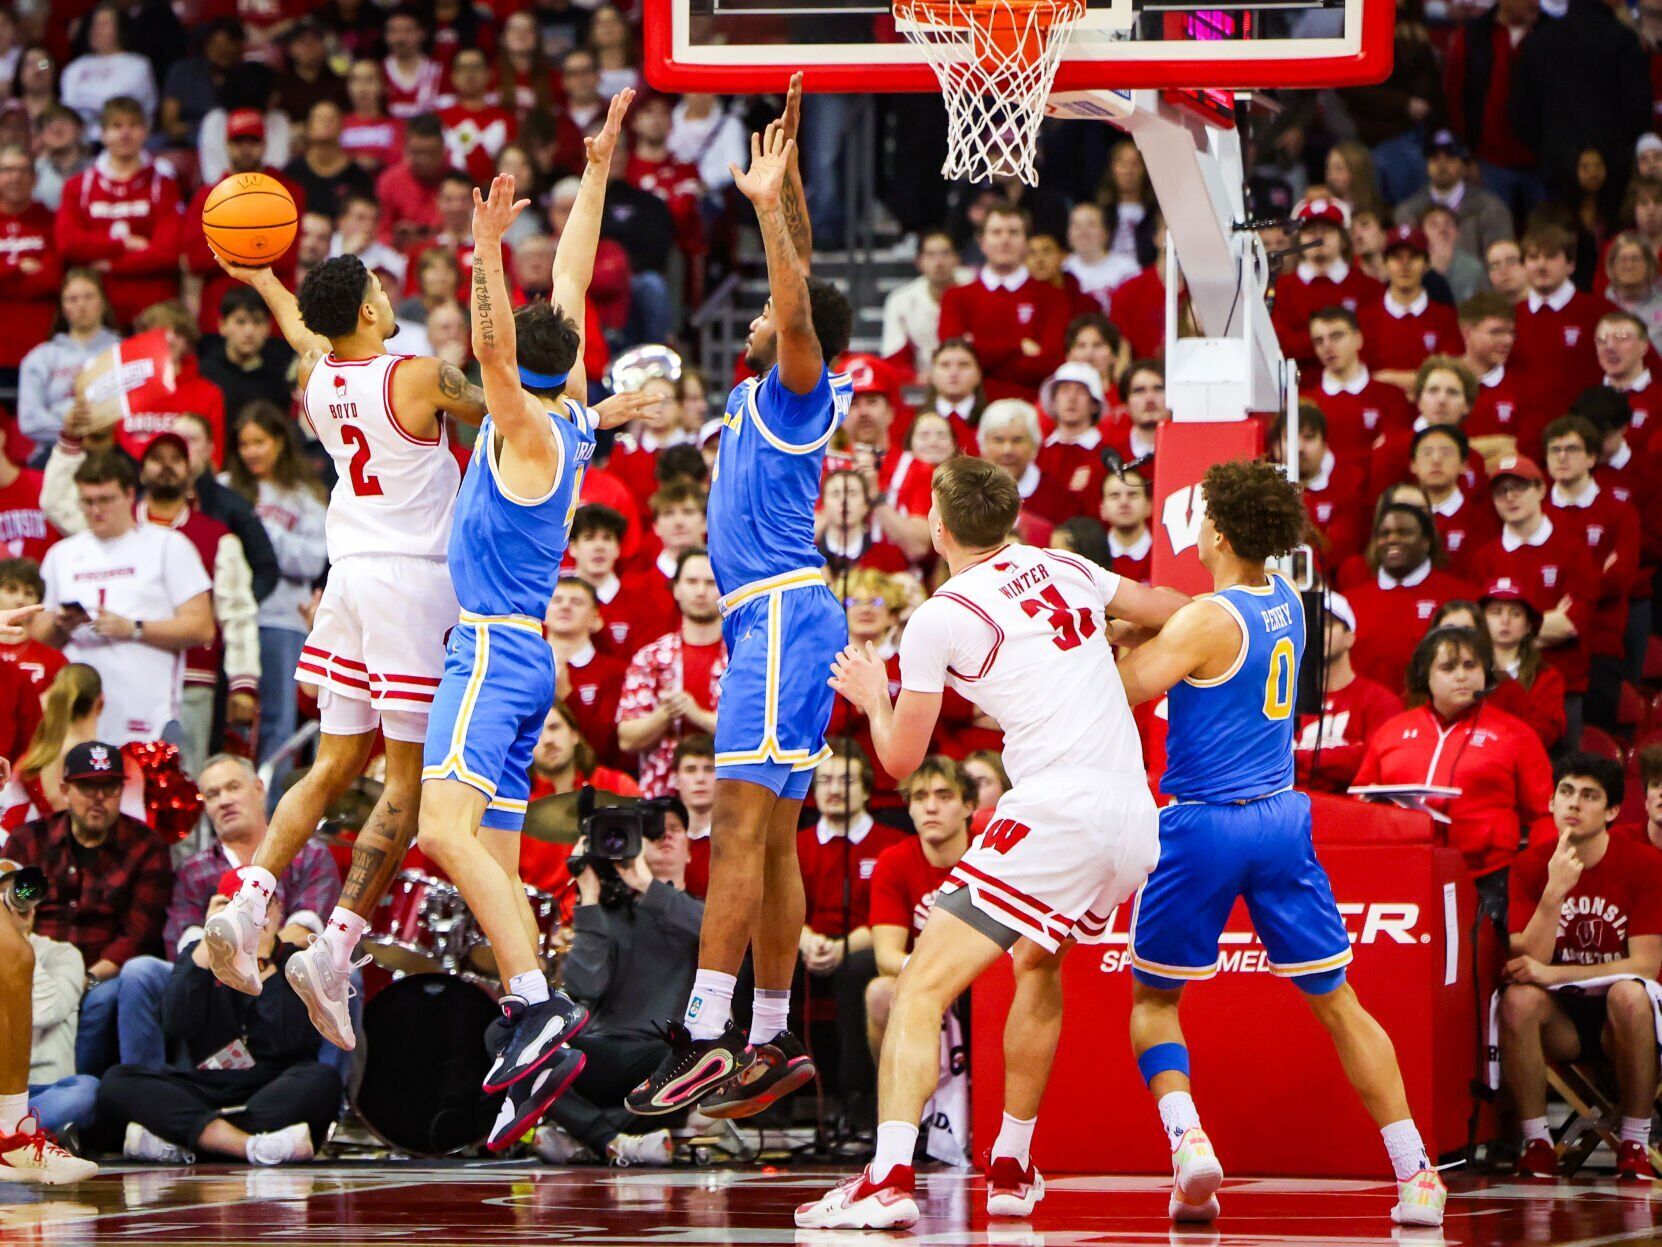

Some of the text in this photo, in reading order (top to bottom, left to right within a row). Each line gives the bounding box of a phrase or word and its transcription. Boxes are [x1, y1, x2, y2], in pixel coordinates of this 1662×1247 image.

[329, 402, 358, 418] BOYD
[341, 424, 384, 496] 2
[998, 563, 1050, 600] WINTER
[1019, 583, 1097, 651] 31
[1261, 602, 1293, 633] PERRY
[1262, 636, 1295, 721] 0
[980, 818, 1031, 855] W
